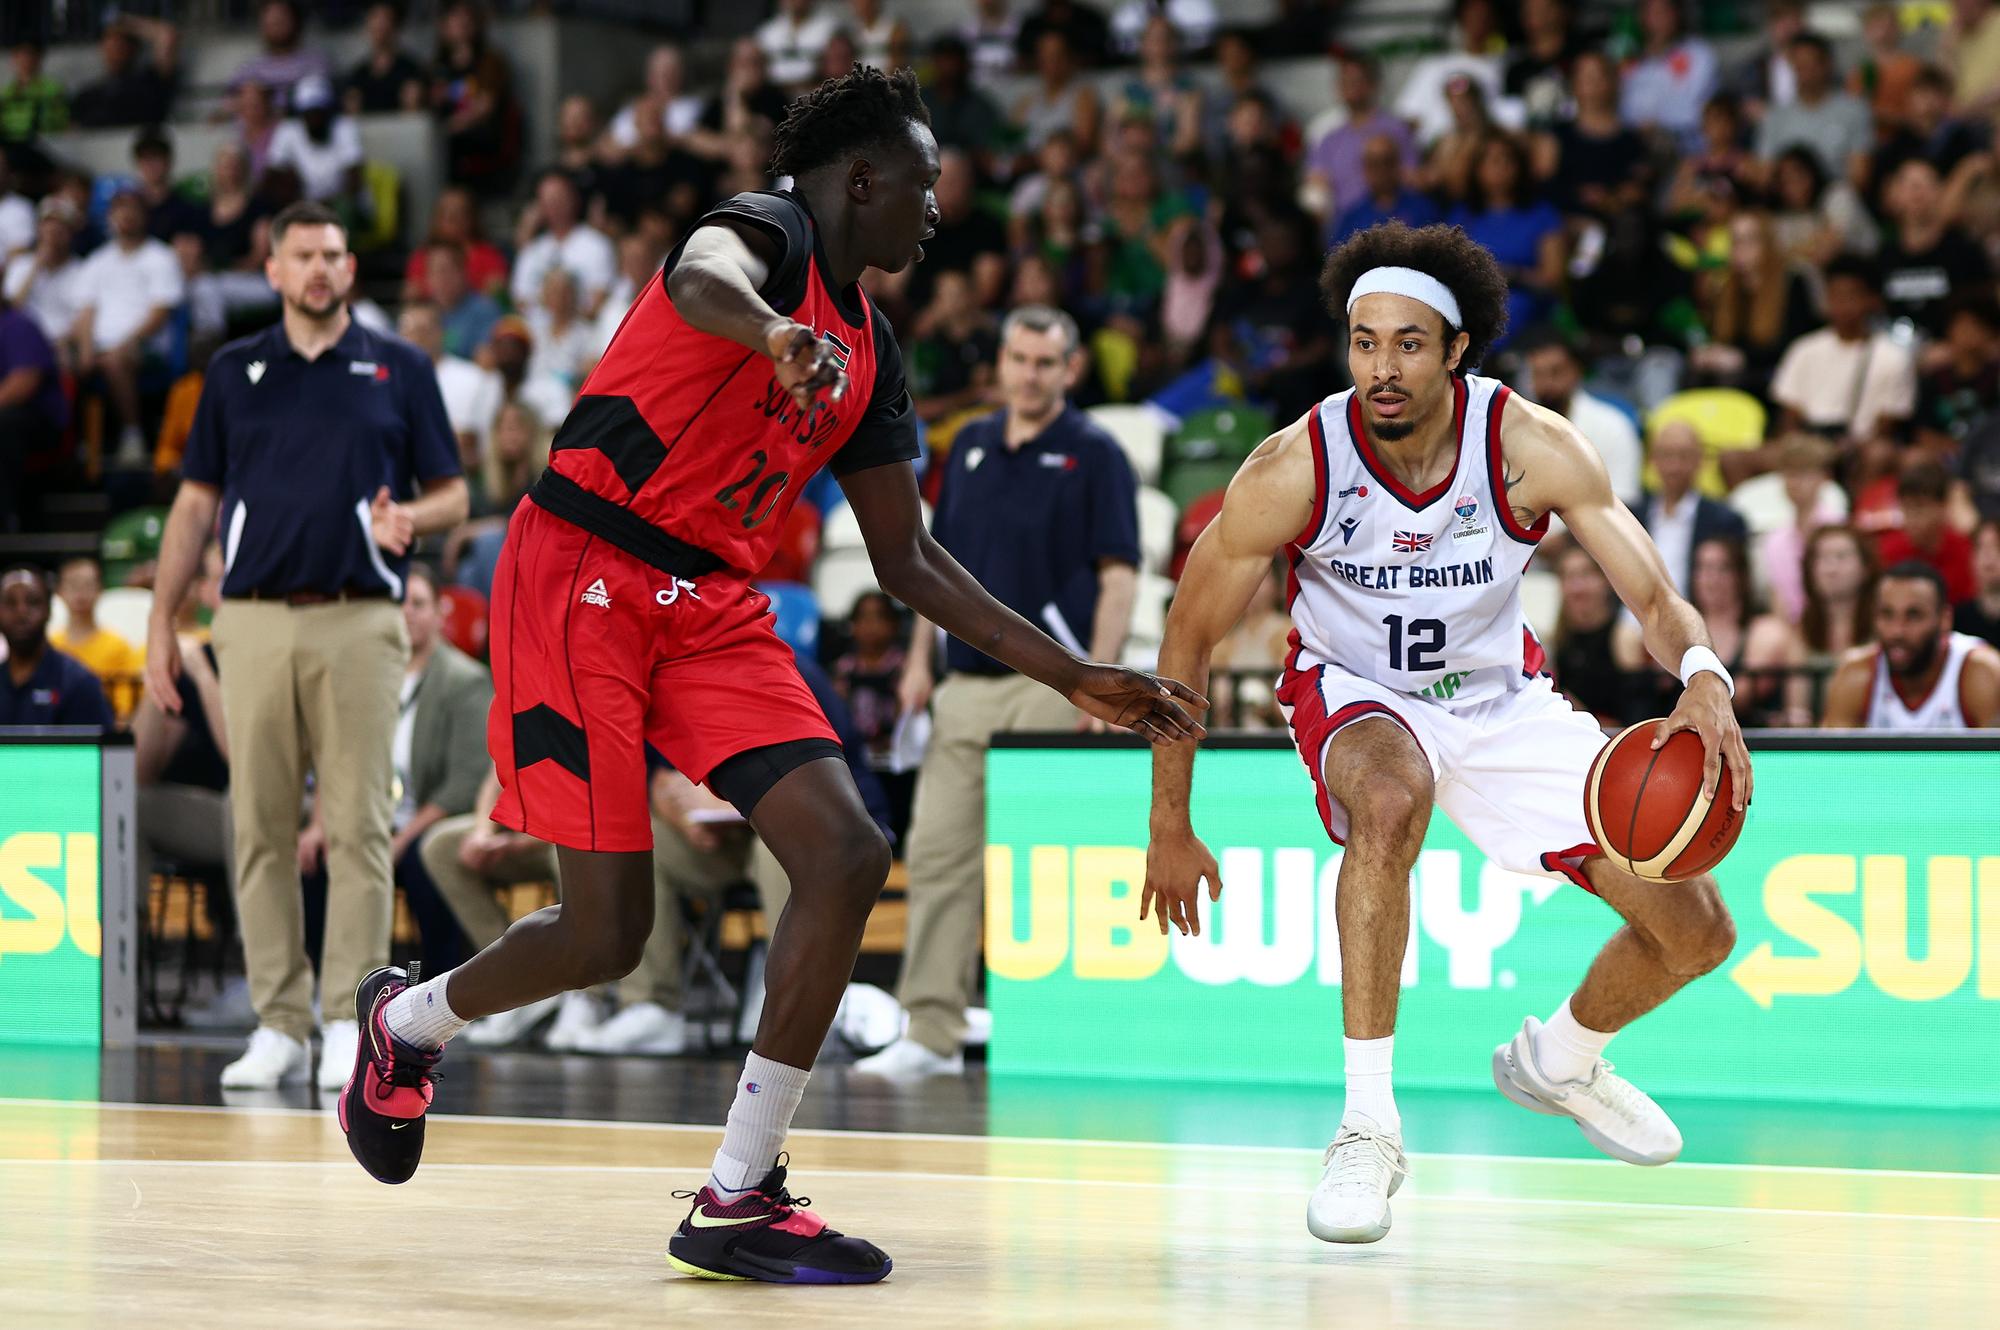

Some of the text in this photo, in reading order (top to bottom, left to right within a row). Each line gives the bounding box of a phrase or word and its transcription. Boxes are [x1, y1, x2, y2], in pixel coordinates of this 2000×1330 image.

[715, 450, 789, 529] 20
[1452, 526, 1489, 539] EUROBASKET
[1331, 556, 1494, 590] GREAT BRITAIN
[580, 592, 613, 609] PEAK
[1382, 613, 1447, 672] 12
[1730, 853, 2000, 1011] SU
